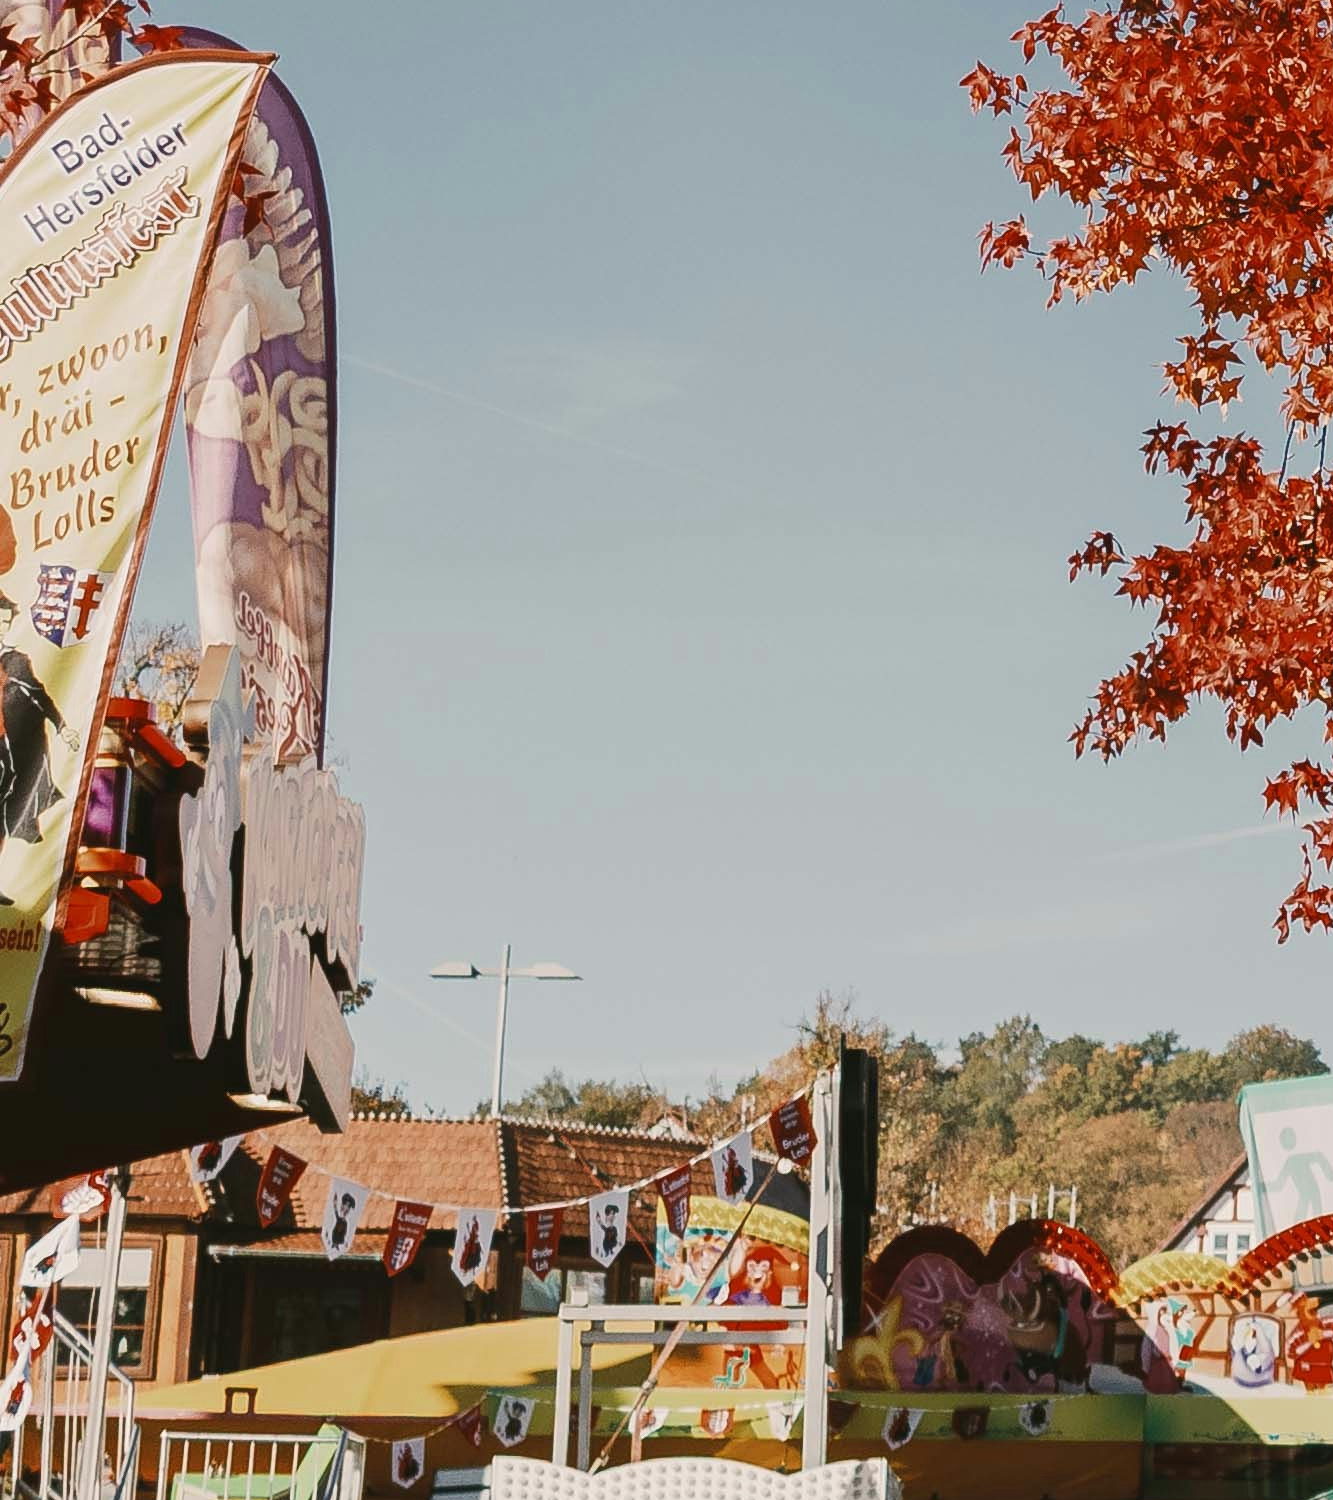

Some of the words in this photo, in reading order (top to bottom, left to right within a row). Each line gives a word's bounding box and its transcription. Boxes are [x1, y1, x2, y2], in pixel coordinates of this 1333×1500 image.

[51, 113, 131, 175] Bad-
[23, 122, 188, 243] Hersfelder
[0, 166, 200, 362] ullusfest
[38, 323, 168, 395] zwoon,
[20, 389, 96, 454] dräi
[10, 435, 140, 510] Bruder
[34, 489, 115, 551] Lolls
